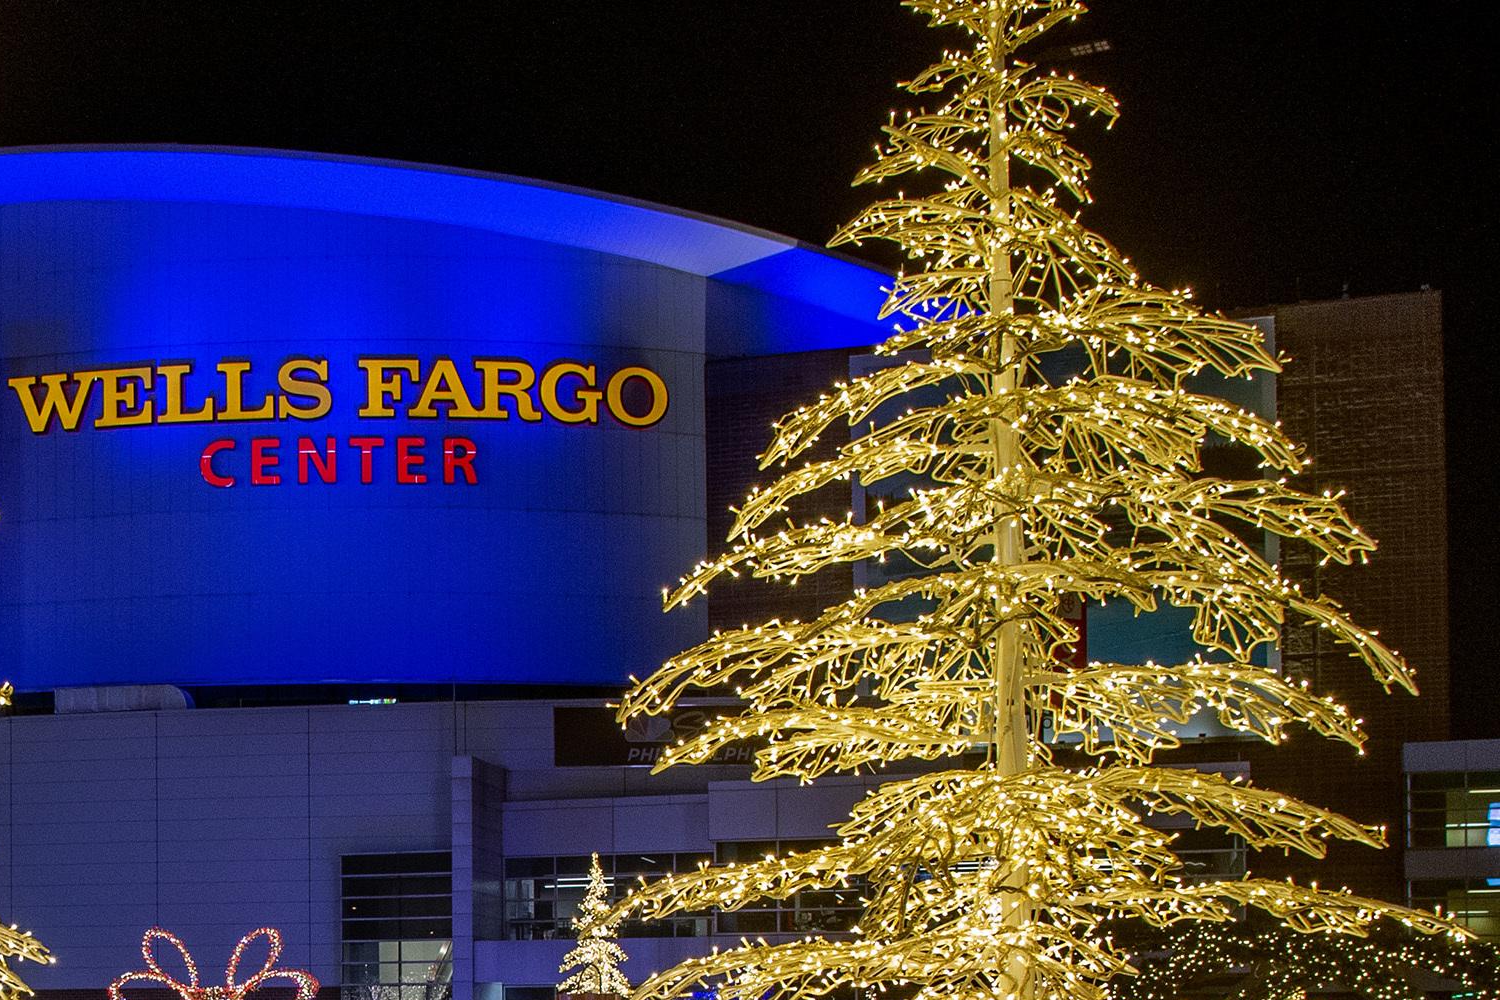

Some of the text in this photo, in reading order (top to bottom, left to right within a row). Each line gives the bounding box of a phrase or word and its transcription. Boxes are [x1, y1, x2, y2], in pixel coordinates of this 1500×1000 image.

[8, 357, 669, 433] WELLS FARGO
[200, 436, 480, 487] CENTER
